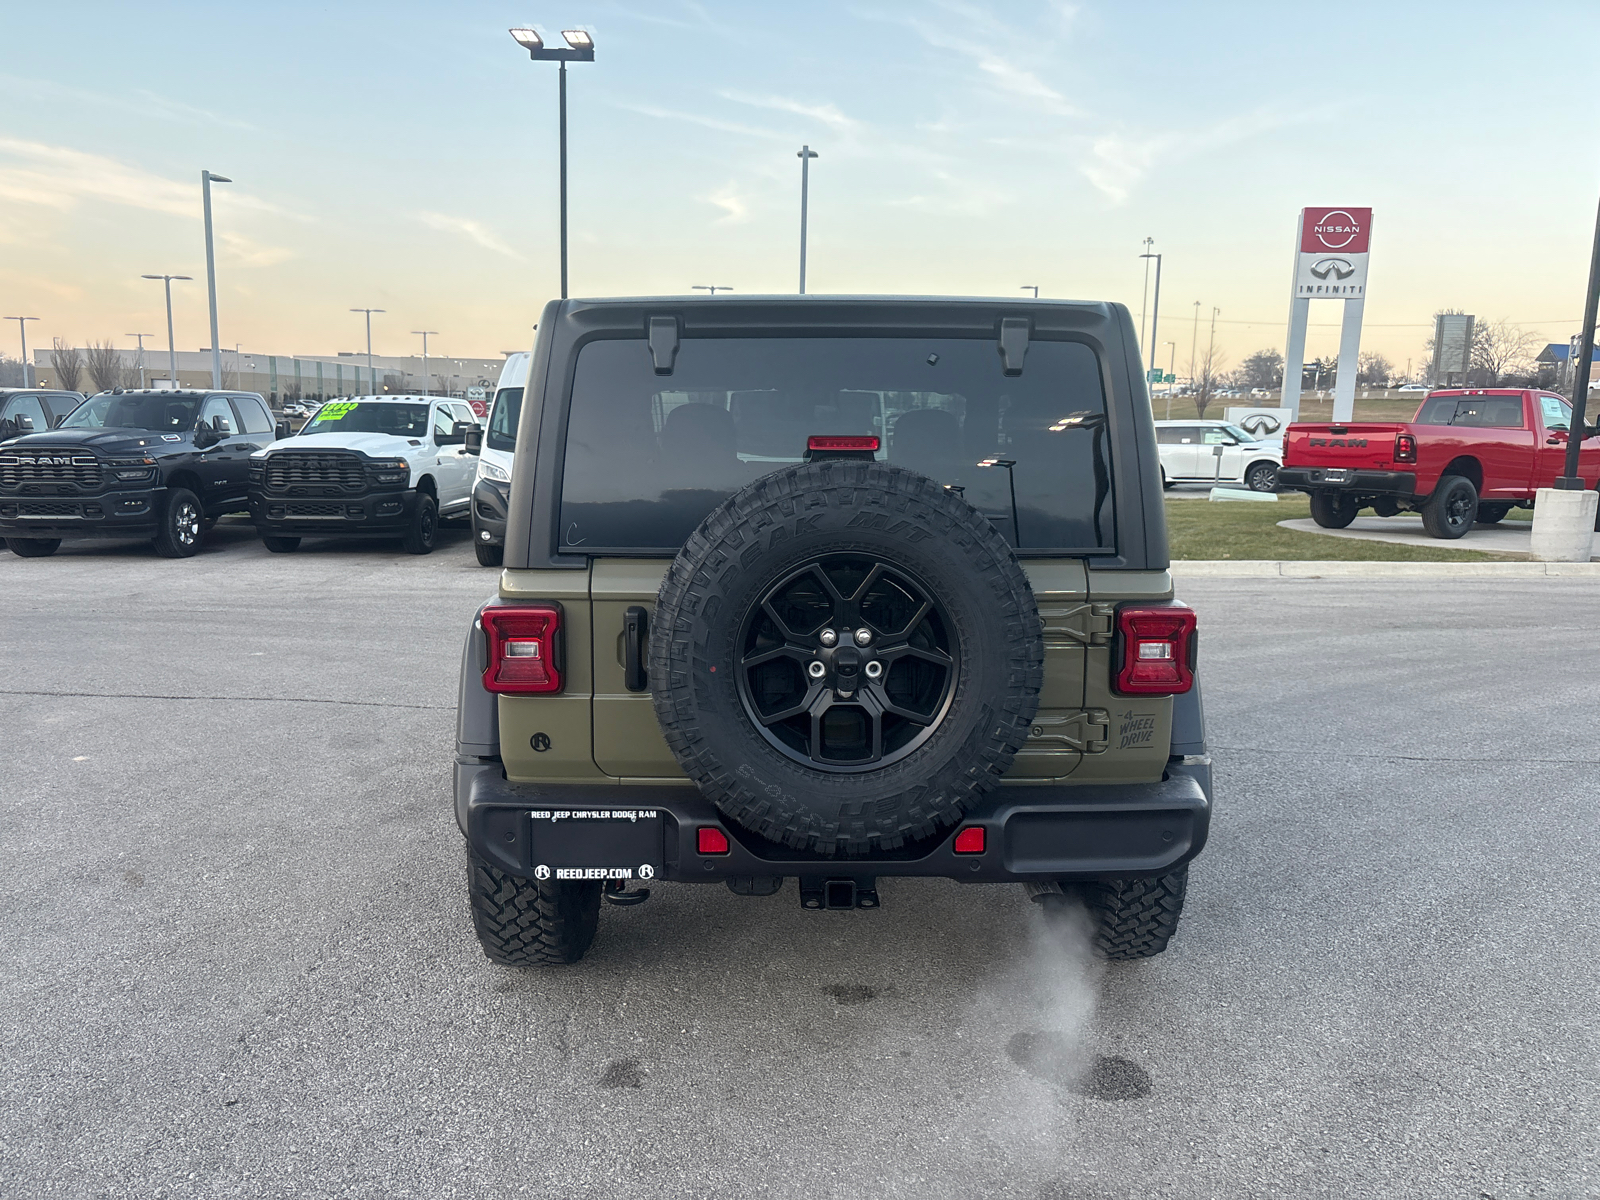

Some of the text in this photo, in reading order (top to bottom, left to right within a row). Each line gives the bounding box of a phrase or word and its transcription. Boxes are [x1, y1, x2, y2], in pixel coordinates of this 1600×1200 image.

[1300, 285, 1362, 294] INFINITI
[1309, 438, 1368, 448] RAM
[19, 456, 71, 465] RAM
[288, 460, 339, 469] RAM
[1124, 710, 1133, 720] 4
[1120, 719, 1155, 735] WHEEL
[1120, 731, 1154, 750] DRIVE
[531, 811, 550, 819] REED
[552, 811, 571, 819] JEEP
[572, 811, 611, 819] CHRYSLER
[556, 868, 632, 879] REEDJEEP.COM
